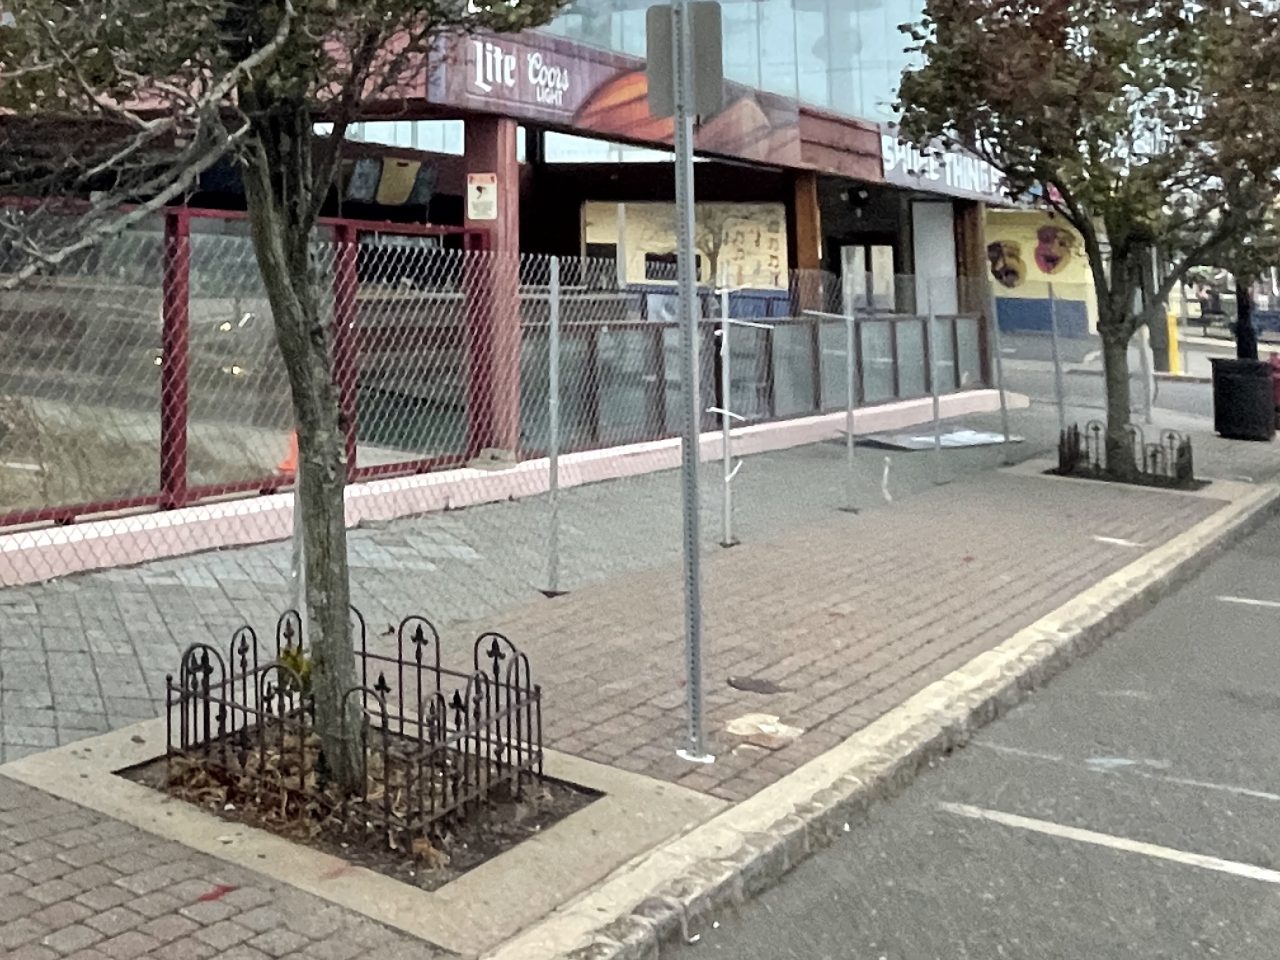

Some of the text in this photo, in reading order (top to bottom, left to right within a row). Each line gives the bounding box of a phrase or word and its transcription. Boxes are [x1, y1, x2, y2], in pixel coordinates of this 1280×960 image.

[473, 40, 516, 92] Lite
[527, 52, 569, 91] Coors
[536, 86, 563, 106] LIGHT
